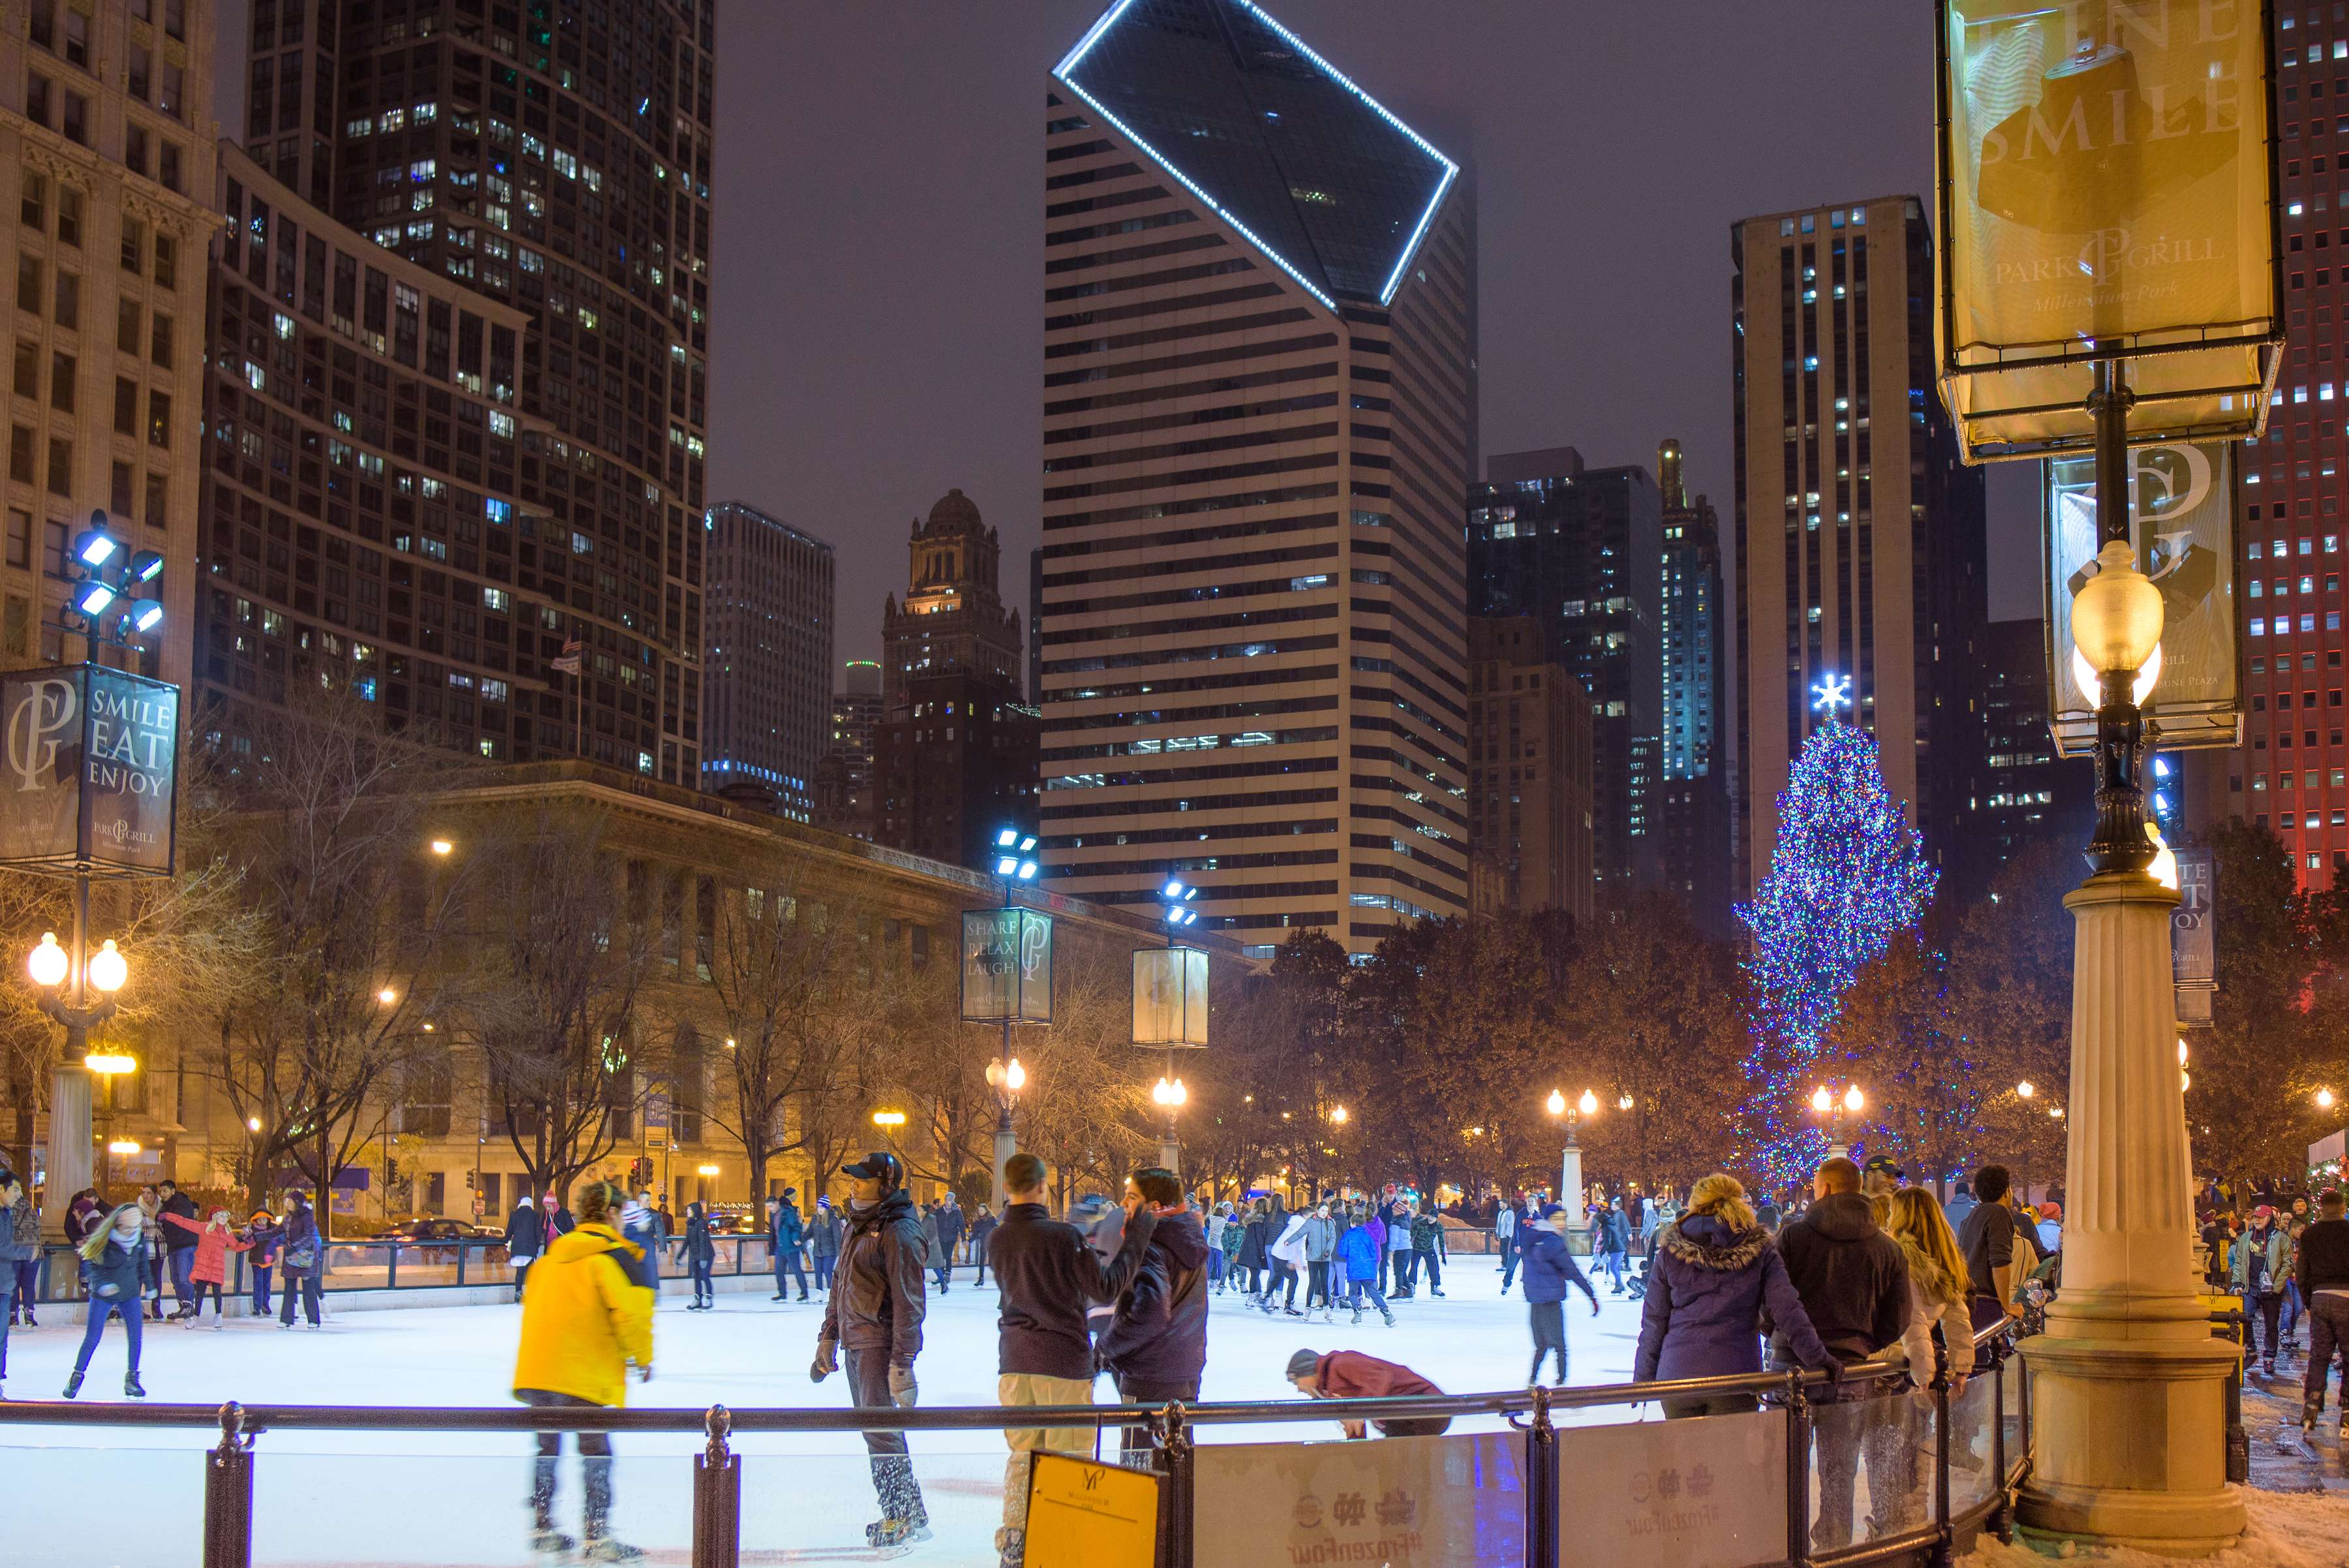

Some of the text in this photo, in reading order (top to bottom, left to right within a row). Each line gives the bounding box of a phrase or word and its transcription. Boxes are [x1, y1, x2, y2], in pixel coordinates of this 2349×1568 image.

[1980, 70, 2241, 166] SMILE
[1995, 256, 2080, 284] PARK
[2127, 238, 2224, 269] GRILL
[2033, 281, 2178, 314] Millennium Park
[92, 689, 170, 730] SMILE
[89, 718, 168, 771] EAT
[89, 761, 166, 797] ENJOY
[94, 822, 113, 836] PARK
[126, 830, 157, 844] GRILL
[968, 921, 1017, 936] SHARE
[968, 941, 1015, 957] RELAX
[968, 962, 1015, 977] LAUGH
